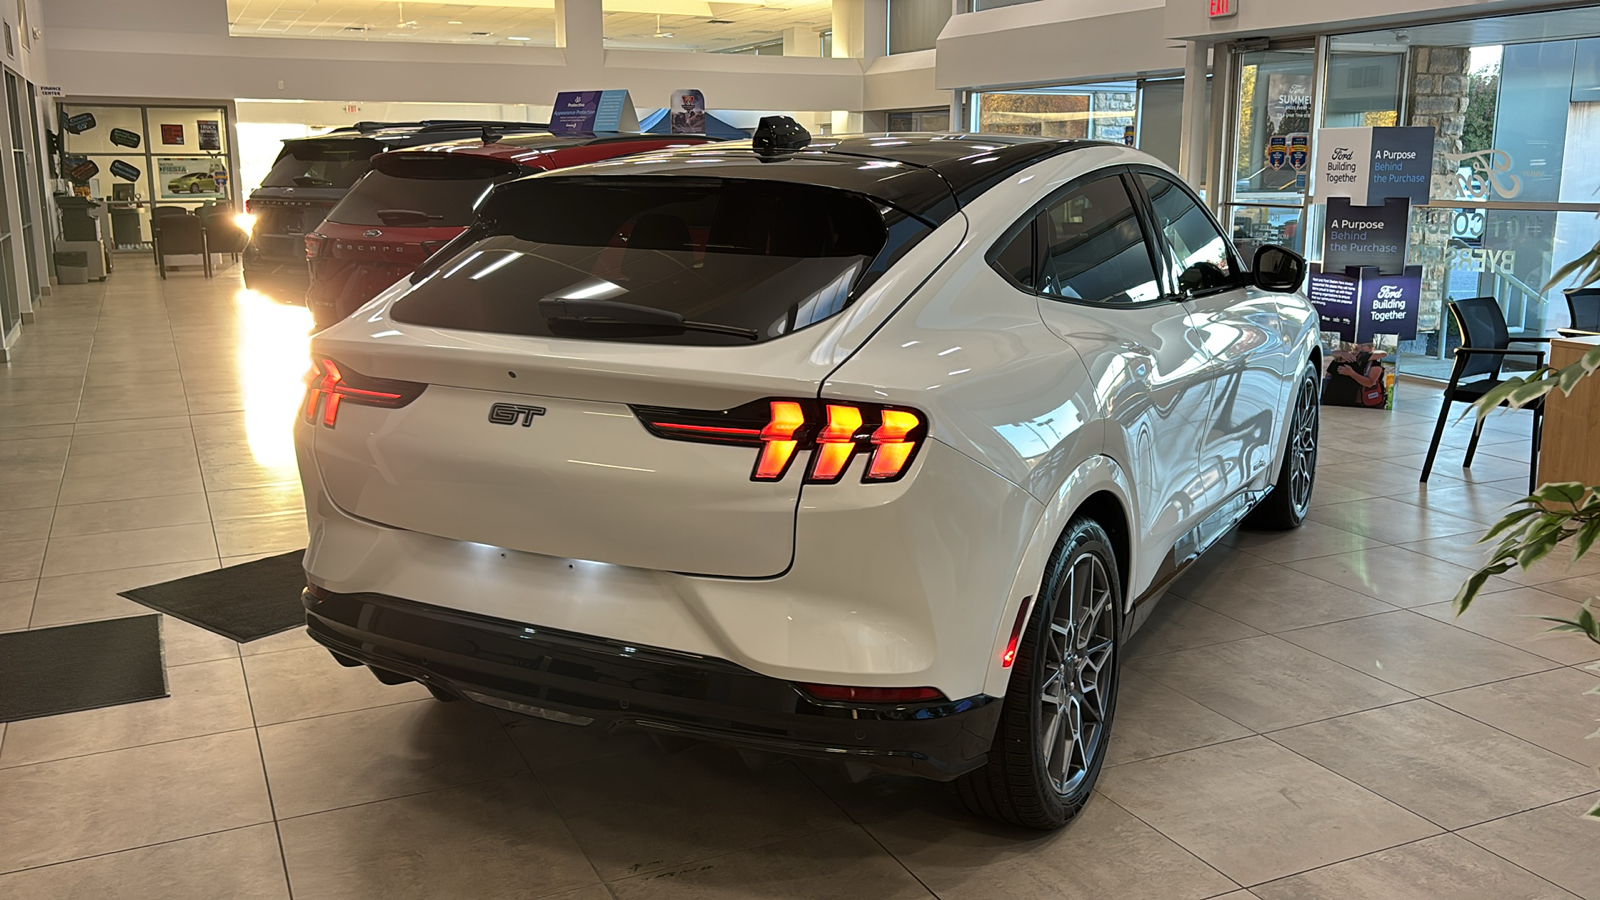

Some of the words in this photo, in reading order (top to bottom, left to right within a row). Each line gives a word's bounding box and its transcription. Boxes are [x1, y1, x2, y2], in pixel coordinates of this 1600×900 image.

[1331, 147, 1354, 160] Ford
[1375, 150, 1382, 159] A
[1383, 150, 1416, 161] Purpose
[1327, 162, 1356, 173] Building
[1374, 162, 1403, 171] Behind
[1326, 173, 1357, 184] Together
[1373, 174, 1387, 182] the
[1388, 174, 1425, 182] Purchase
[1331, 219, 1339, 228] A
[1341, 219, 1385, 231] Purpose
[1331, 231, 1367, 240] Behind
[336, 244, 404, 252] ESCAPE
[1330, 243, 1347, 252] the
[1350, 243, 1398, 252] Purchase
[1377, 285, 1403, 299] Ford
[1373, 299, 1406, 310] Building
[1370, 310, 1407, 322] Together
[488, 402, 546, 427] GT
